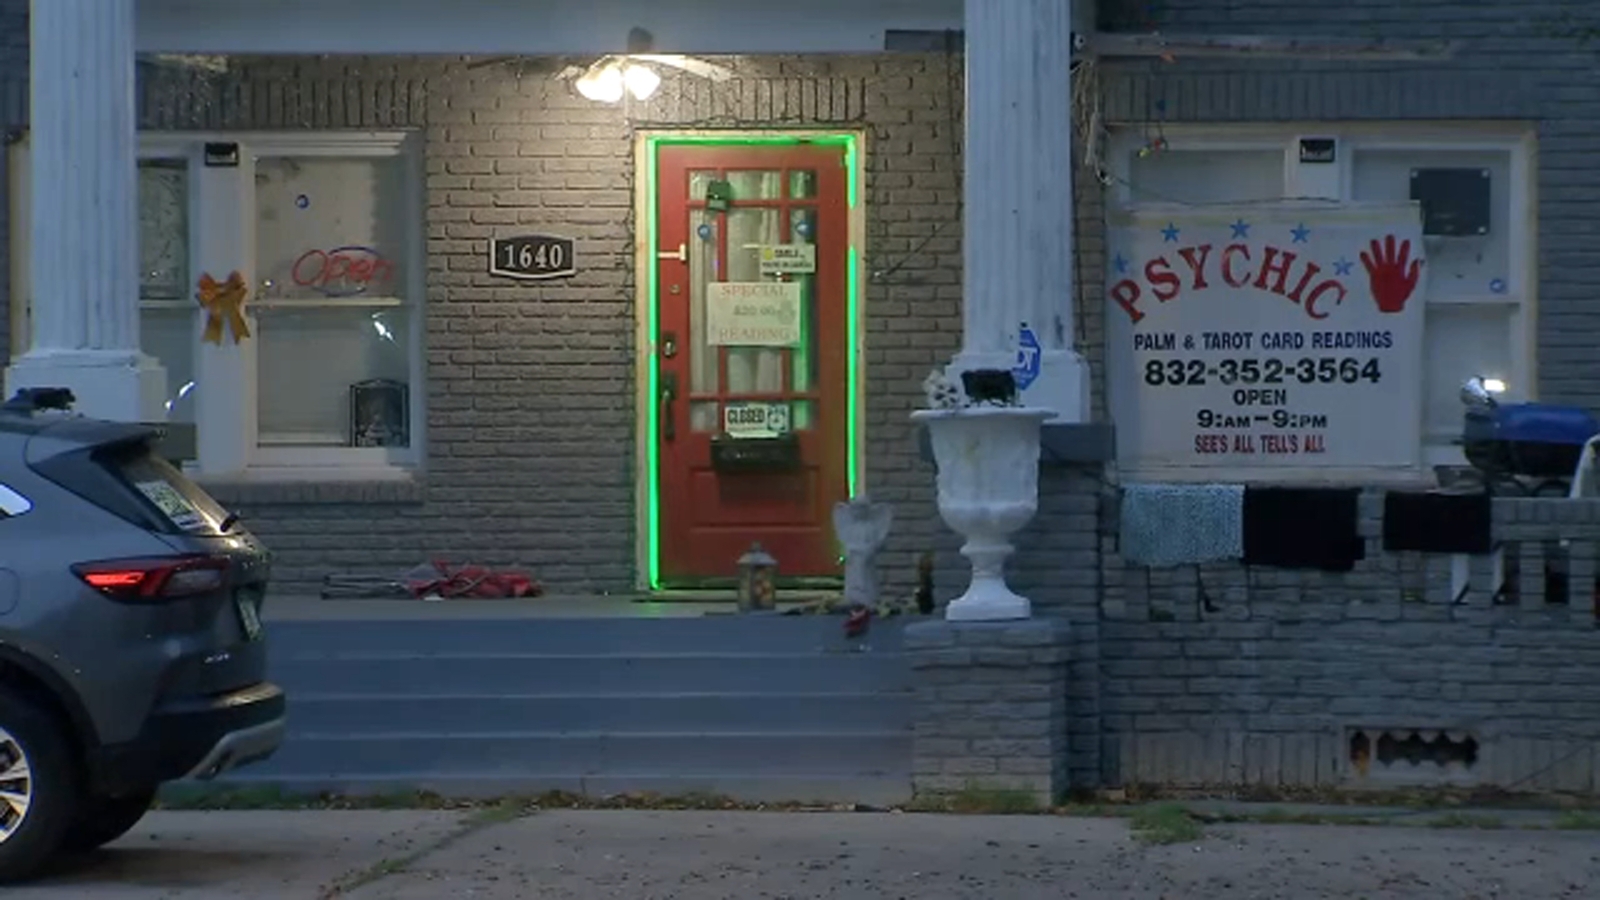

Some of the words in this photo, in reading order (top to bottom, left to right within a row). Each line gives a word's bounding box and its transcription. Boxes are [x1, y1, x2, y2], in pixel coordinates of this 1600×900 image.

[504, 244, 564, 268] 1640
[291, 249, 395, 287] Open
[720, 285, 789, 298] SPECIAL
[1111, 243, 1348, 325] PSYCHIC
[1134, 333, 1176, 351] PALM
[1184, 334, 1195, 350] &
[1203, 332, 1253, 350] TAROT
[1261, 332, 1304, 349] CARD
[1312, 331, 1393, 349] READINGS
[1144, 358, 1382, 385] 832-352-3564
[1233, 388, 1287, 406] OPEN
[728, 408, 766, 425] CLOSED
[1194, 434, 1228, 454] SEE'S
[1233, 434, 1255, 454] ALL
[1260, 434, 1298, 454] TELL'S
[1304, 434, 1326, 454] ALL
